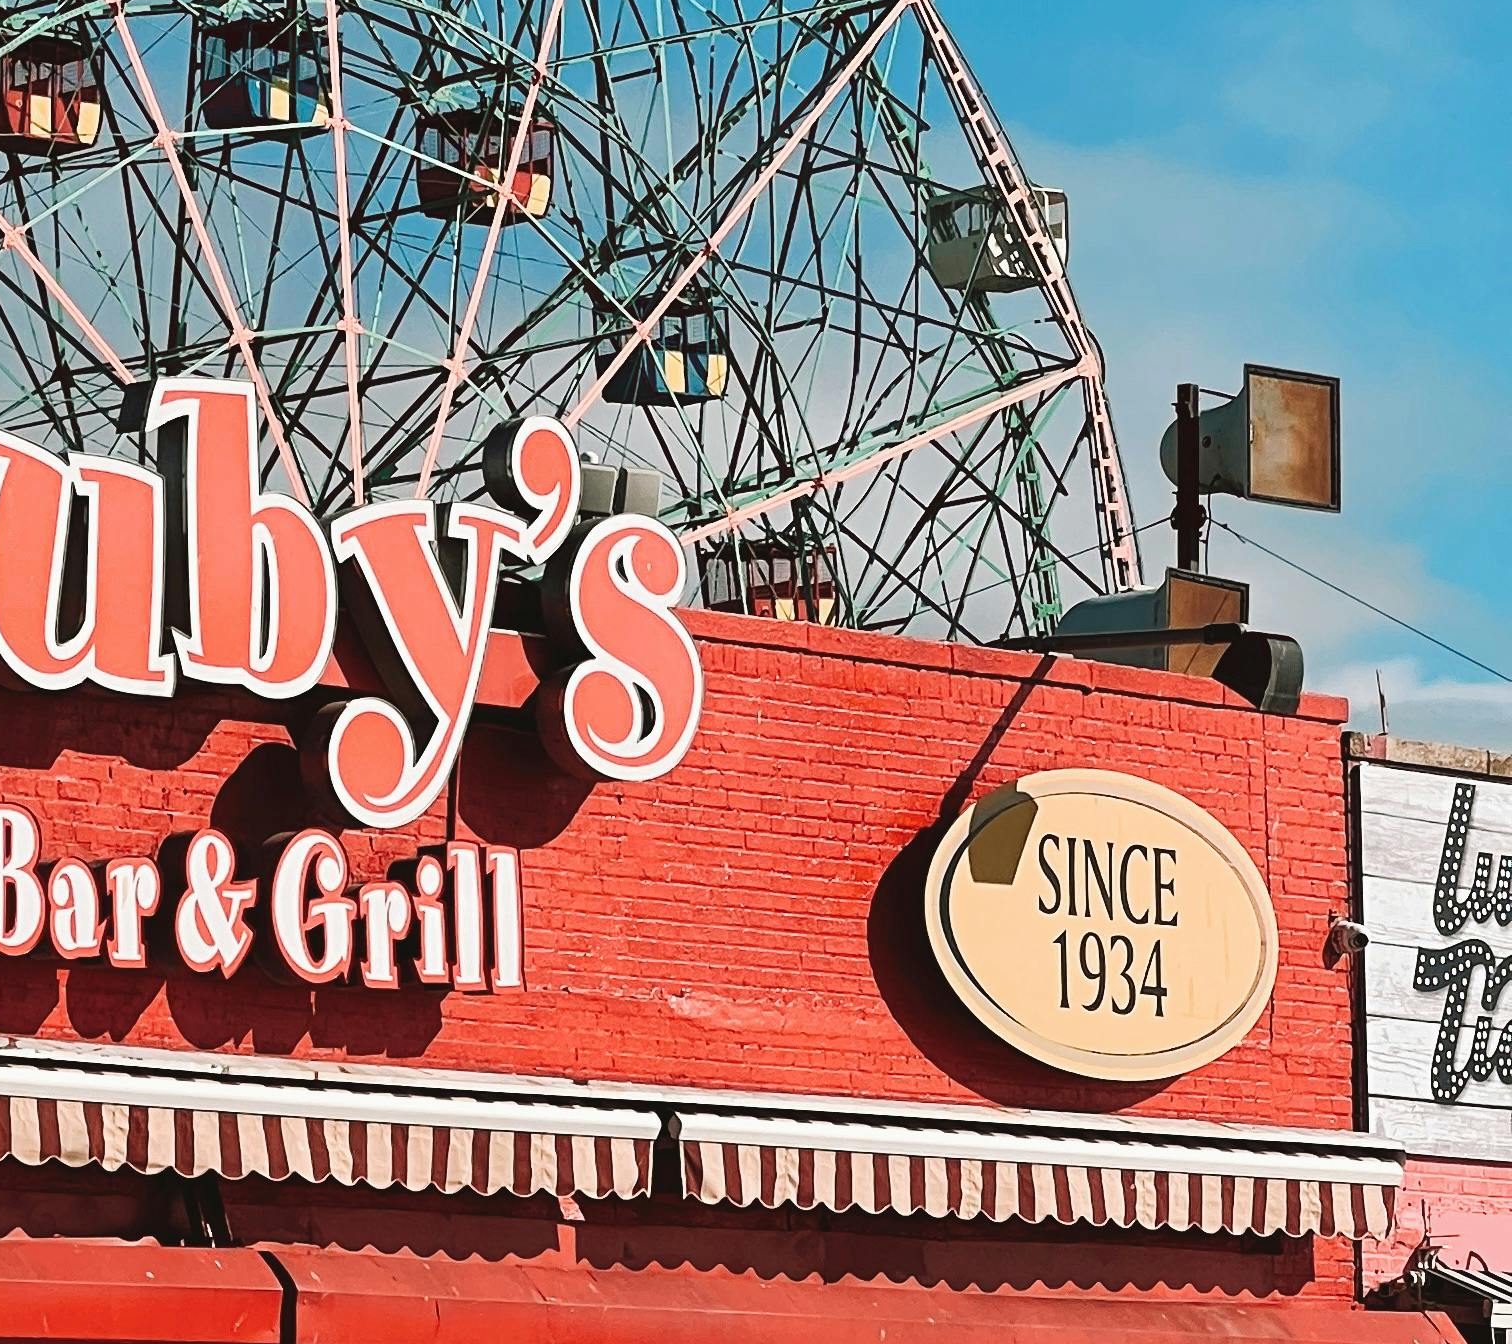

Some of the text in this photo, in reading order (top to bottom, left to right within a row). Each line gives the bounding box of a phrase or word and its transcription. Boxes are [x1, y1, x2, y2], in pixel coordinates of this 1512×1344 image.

[175, 828, 257, 982] &
[272, 828, 525, 992] Grill
[1037, 833, 1179, 928] SINCE
[1051, 930, 1169, 1018] 1934
